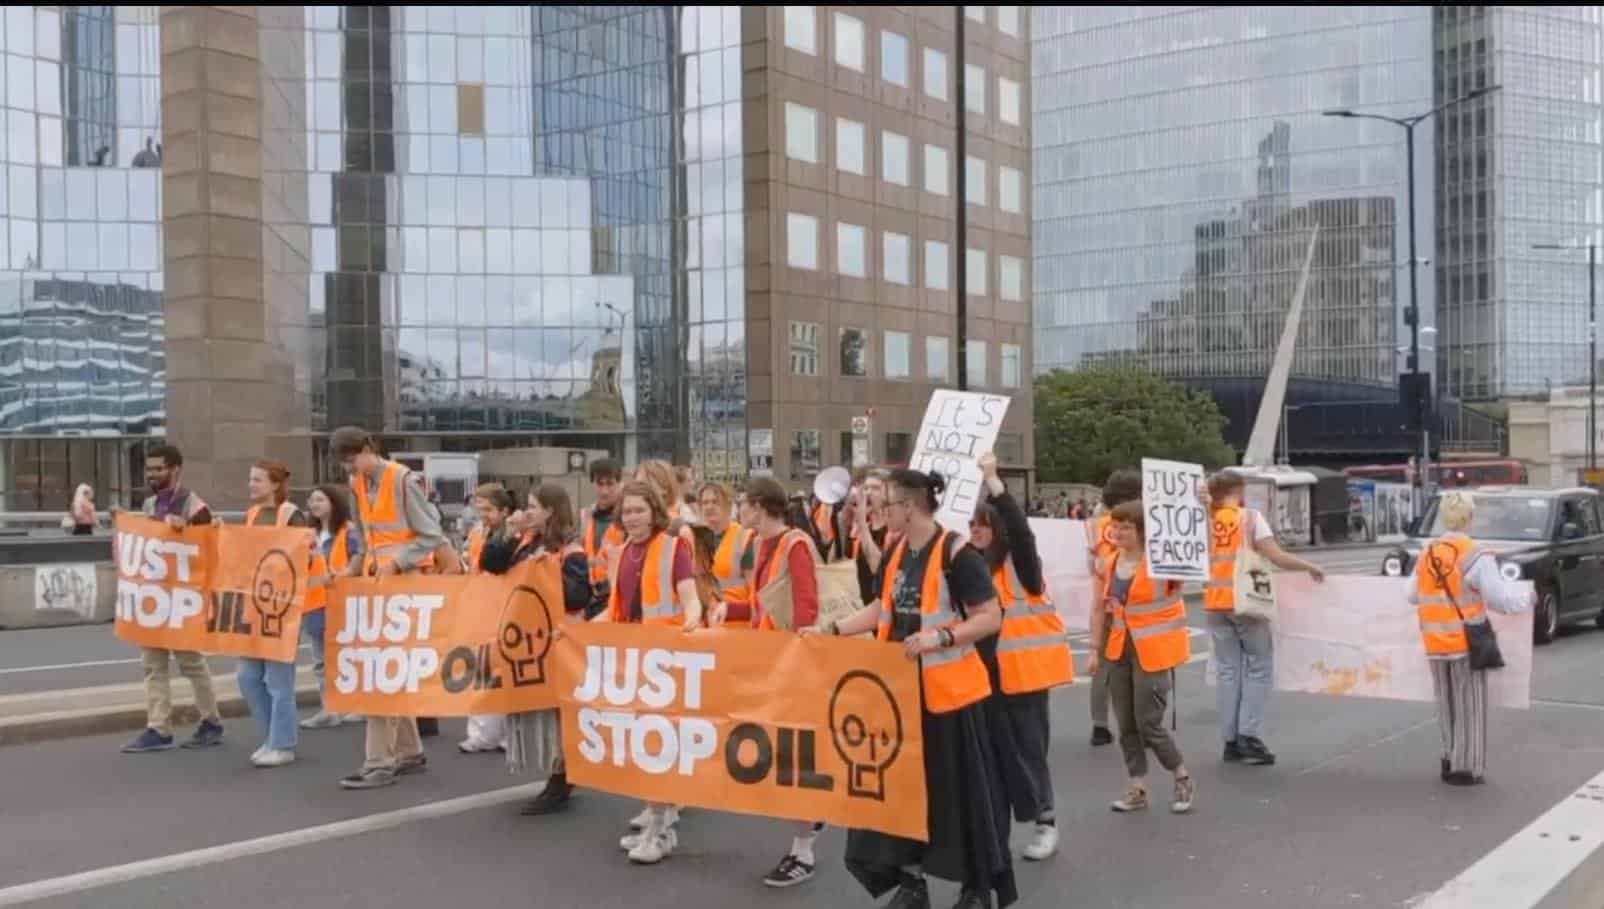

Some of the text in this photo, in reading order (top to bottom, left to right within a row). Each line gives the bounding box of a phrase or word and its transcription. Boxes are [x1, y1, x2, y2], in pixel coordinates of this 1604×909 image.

[925, 429, 984, 458] NOT
[1147, 470, 1201, 497] JUST
[1149, 503, 1205, 538] STOP
[116, 531, 199, 582] UST
[1148, 539, 1206, 564] EACOP
[115, 579, 204, 629] TOP
[335, 594, 445, 644] JUST
[334, 645, 503, 694] STOP OIL
[573, 645, 716, 709] JUST
[577, 707, 834, 792] STOP OIL
